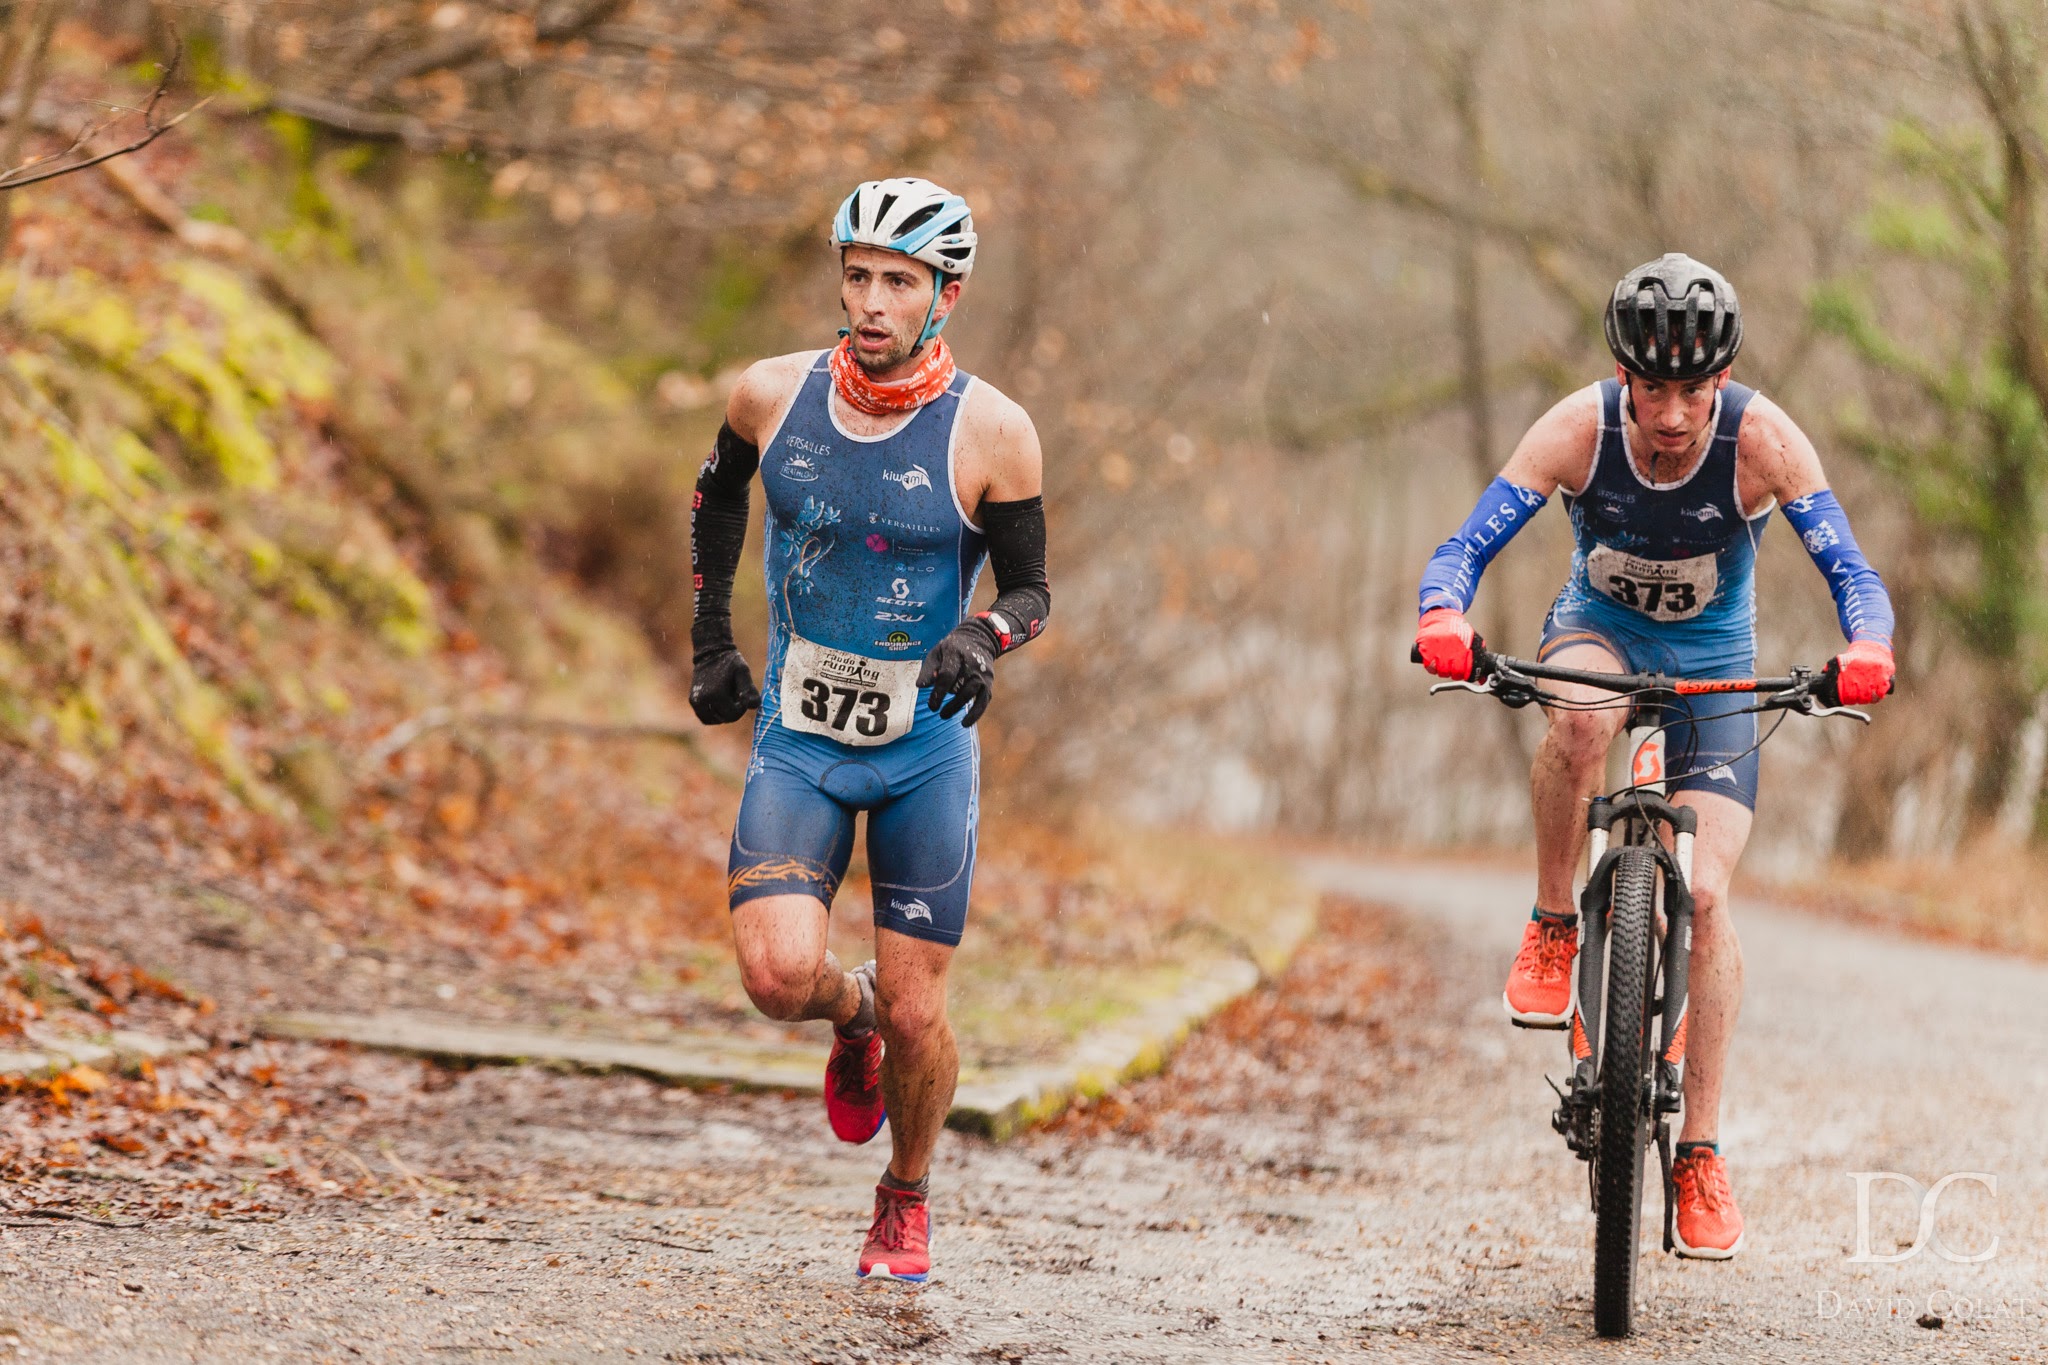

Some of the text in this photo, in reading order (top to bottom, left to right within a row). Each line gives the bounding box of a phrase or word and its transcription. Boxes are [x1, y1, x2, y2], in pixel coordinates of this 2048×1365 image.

[785, 435, 831, 457] VERSAILLES
[882, 468, 924, 487] kiwami
[881, 517, 941, 533] VERSAILLES
[875, 596, 926, 608] SCOTT
[1608, 575, 1697, 613] 373
[874, 610, 925, 623] 2XU
[826, 653, 855, 666] rando
[823, 660, 880, 682] running
[1688, 679, 1758, 694] syncros
[801, 676, 891, 737] 373
[890, 898, 925, 918] kiwami
